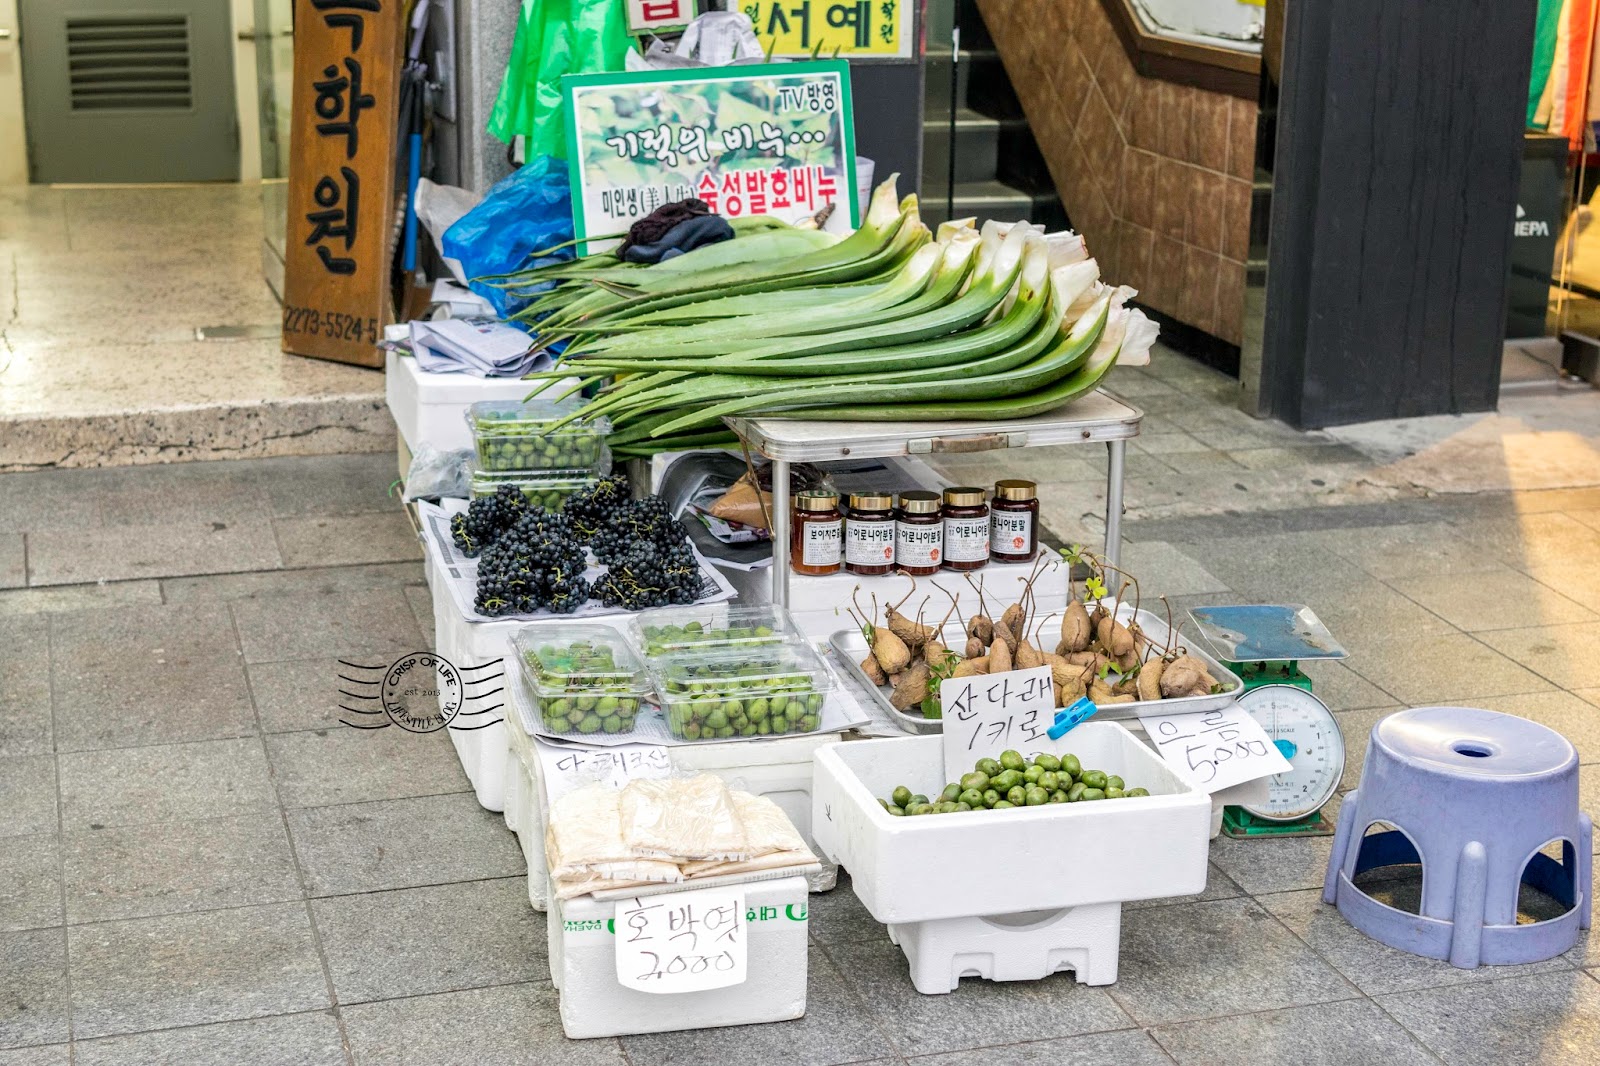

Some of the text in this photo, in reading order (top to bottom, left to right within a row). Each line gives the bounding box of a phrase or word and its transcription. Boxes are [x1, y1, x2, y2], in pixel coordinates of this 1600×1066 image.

[767, 1, 871, 48] 서예
[779, 82, 834, 111] TV방영
[606, 123, 709, 166] 기적의
[698, 166, 837, 216] 숙성발효비누
[284, 306, 378, 344] 2273-5524-5
[853, 529, 893, 541] 아로니아분말
[947, 676, 1052, 721] 산다래
[1158, 710, 1240, 746] 으름
[624, 896, 740, 950] 호박엿
